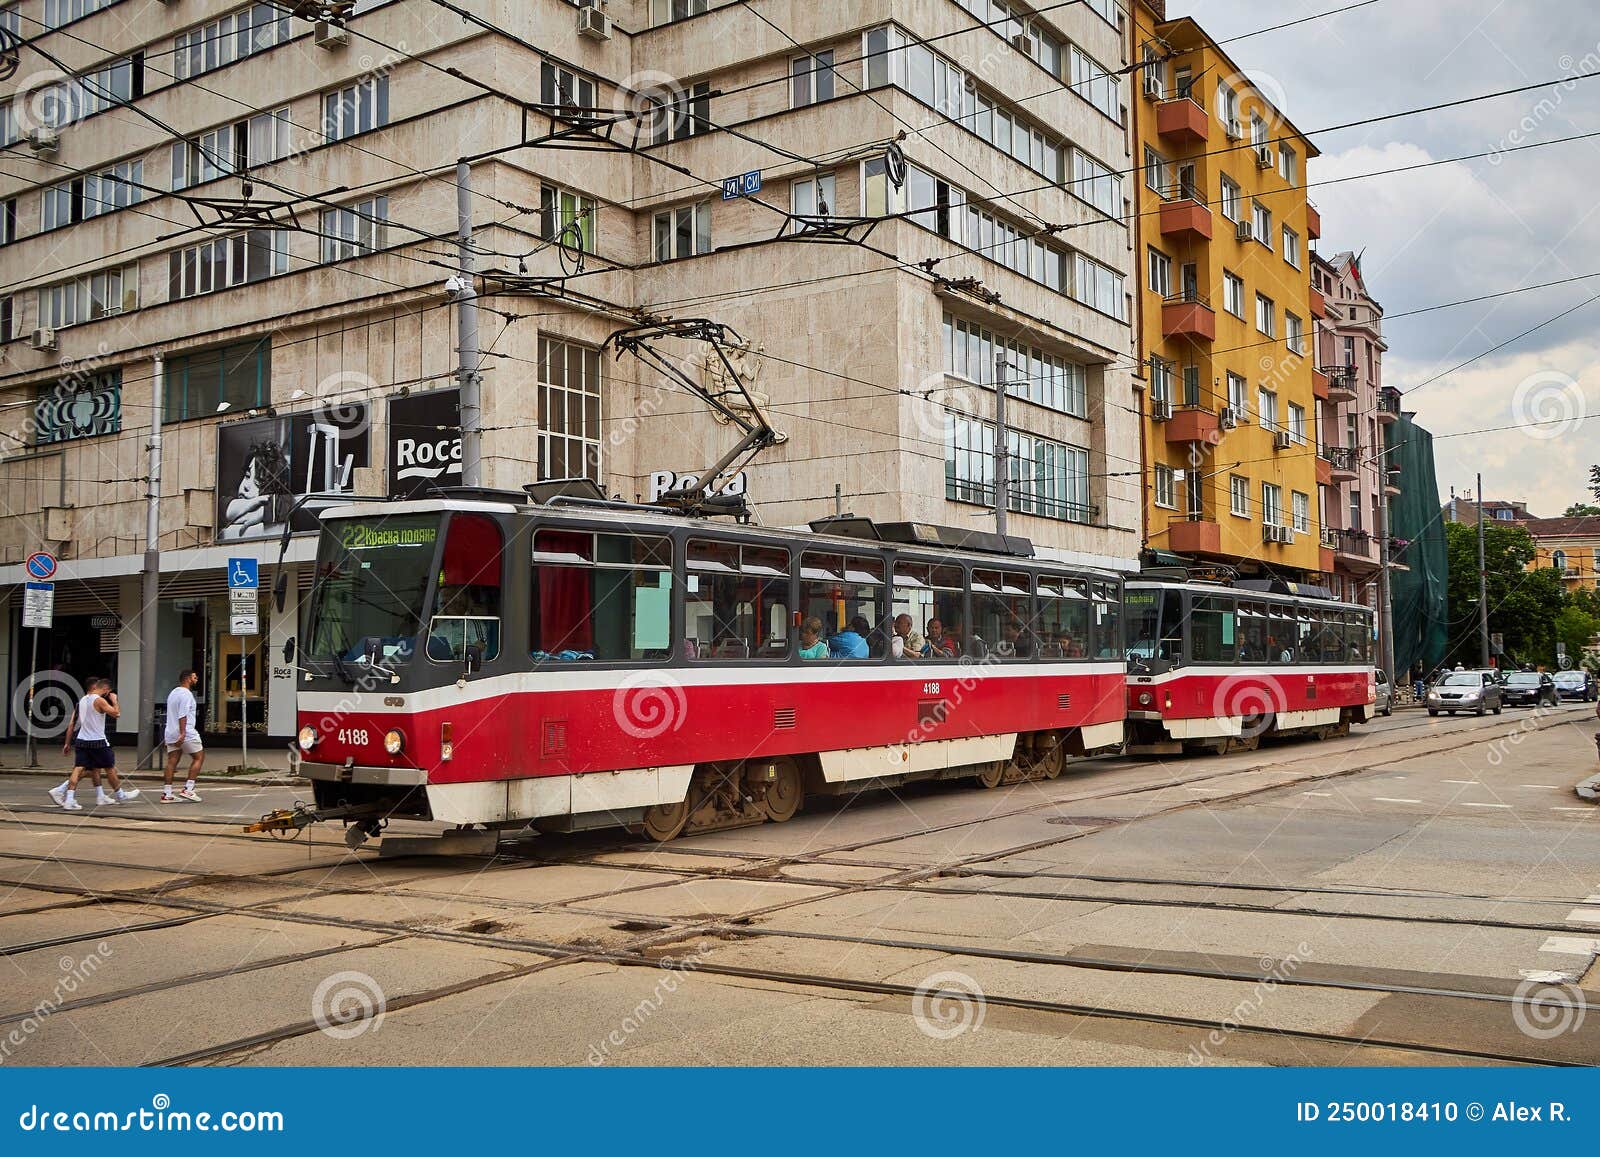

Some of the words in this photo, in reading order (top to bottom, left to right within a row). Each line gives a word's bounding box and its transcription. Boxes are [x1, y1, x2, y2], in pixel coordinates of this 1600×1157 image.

[397, 438, 463, 466] Roca
[342, 523, 365, 548] 22
[338, 728, 369, 746] 4188
